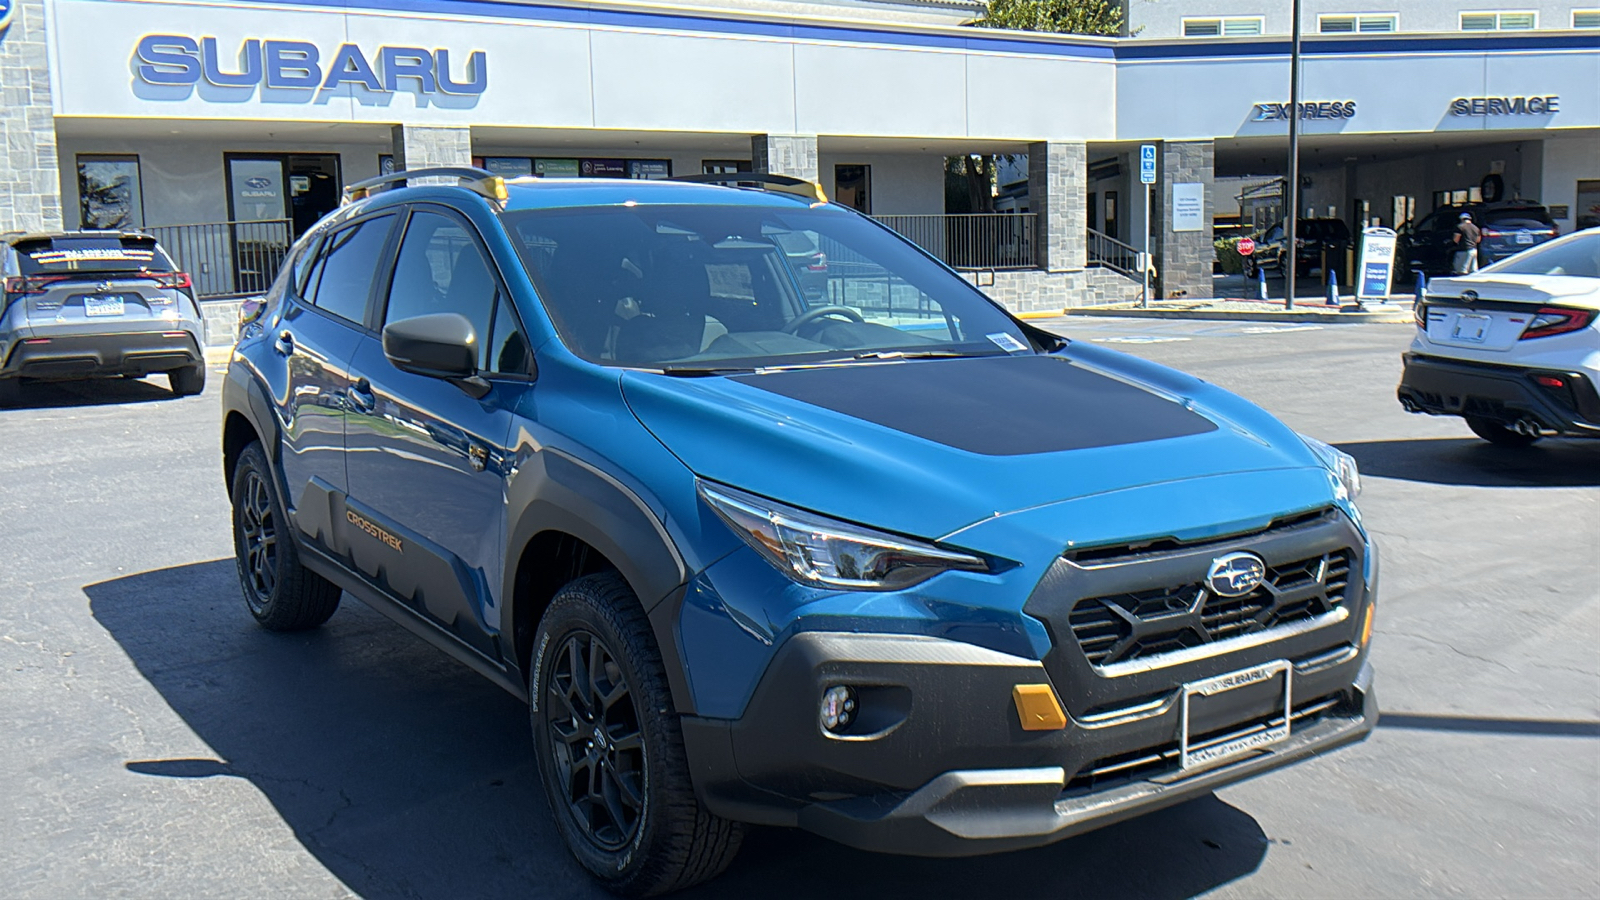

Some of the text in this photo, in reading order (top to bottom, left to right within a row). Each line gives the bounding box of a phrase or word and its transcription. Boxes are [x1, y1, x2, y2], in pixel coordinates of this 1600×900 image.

[136, 34, 488, 95] SUBARU
[1452, 96, 1560, 115] SERVICE
[1237, 242, 1255, 250] STOP
[346, 510, 404, 555] CROSSTREK
